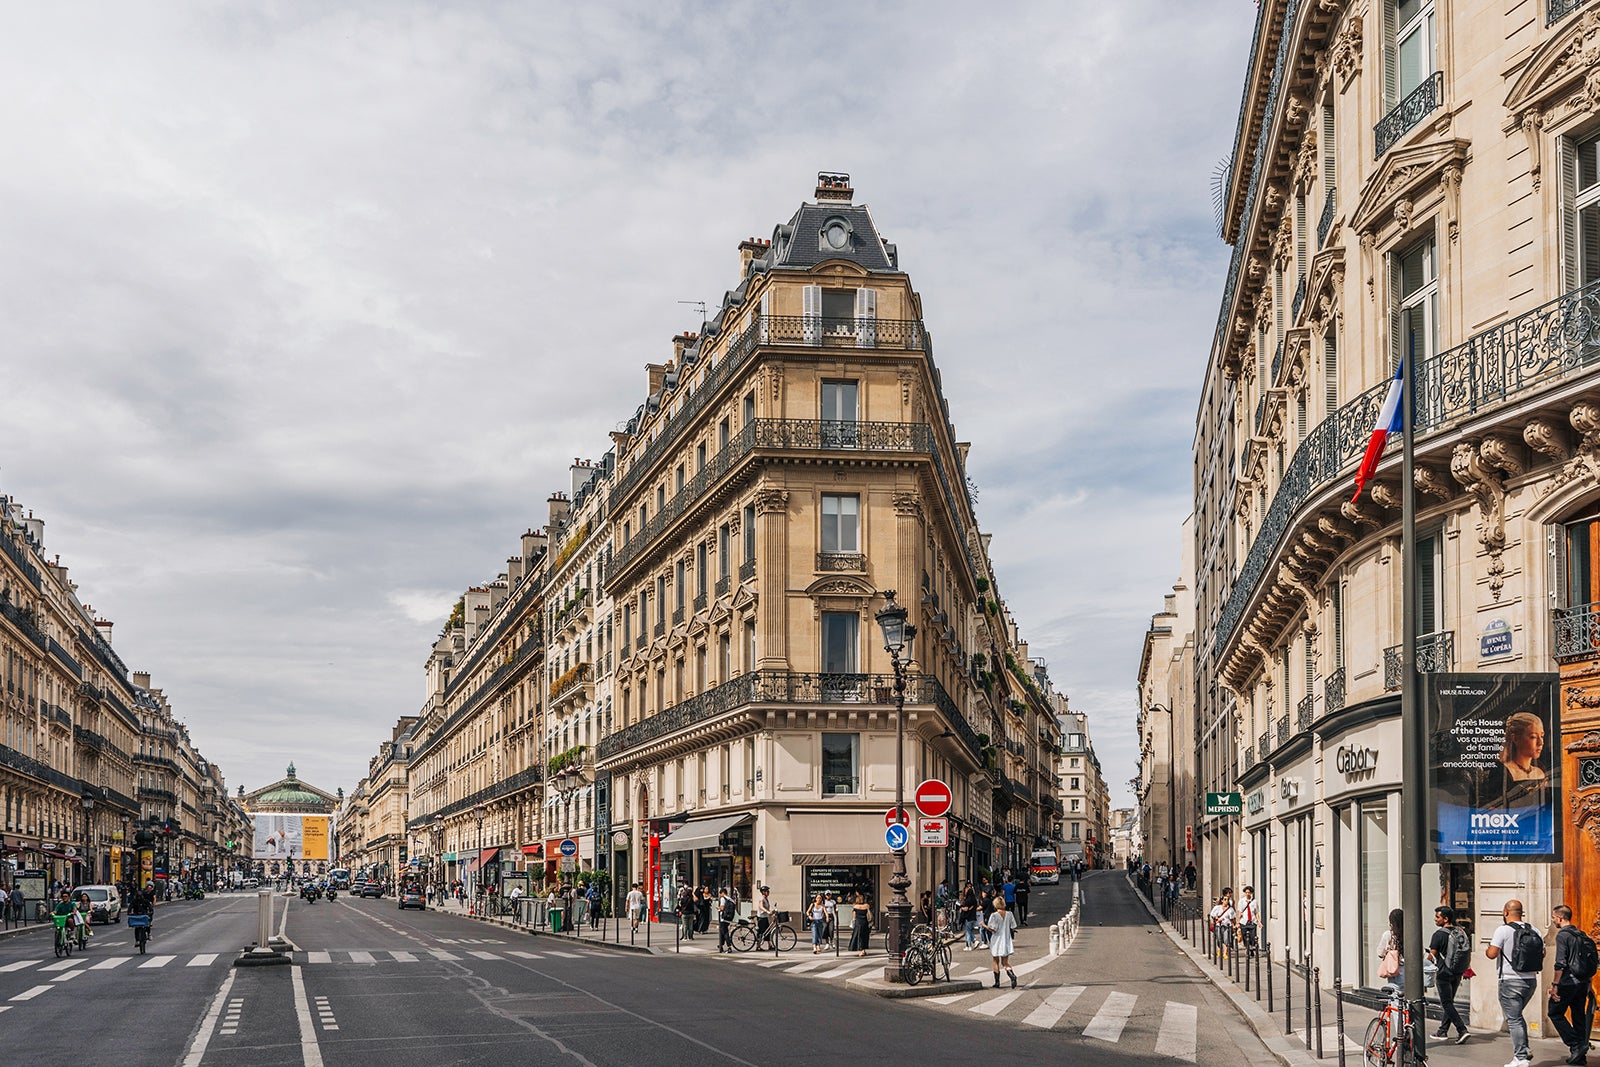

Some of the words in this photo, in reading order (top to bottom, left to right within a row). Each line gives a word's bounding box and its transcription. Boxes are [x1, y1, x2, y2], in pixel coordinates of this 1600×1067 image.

[1486, 635, 1507, 644] AVENUE
[1481, 647, 1489, 655] DE
[1490, 643, 1512, 653] L'OPÉRA
[1455, 719, 1478, 728] Après
[1450, 726, 1460, 735] of
[1460, 727, 1474, 735] the
[1471, 736, 1506, 744] querelles
[1478, 743, 1504, 751] famille
[1336, 743, 1370, 774] Gabor
[1460, 751, 1500, 761] paraîtront
[1442, 761, 1498, 770] anecdotiques.
[1208, 805, 1240, 813] MEPHISTO
[1471, 813, 1519, 828] max
